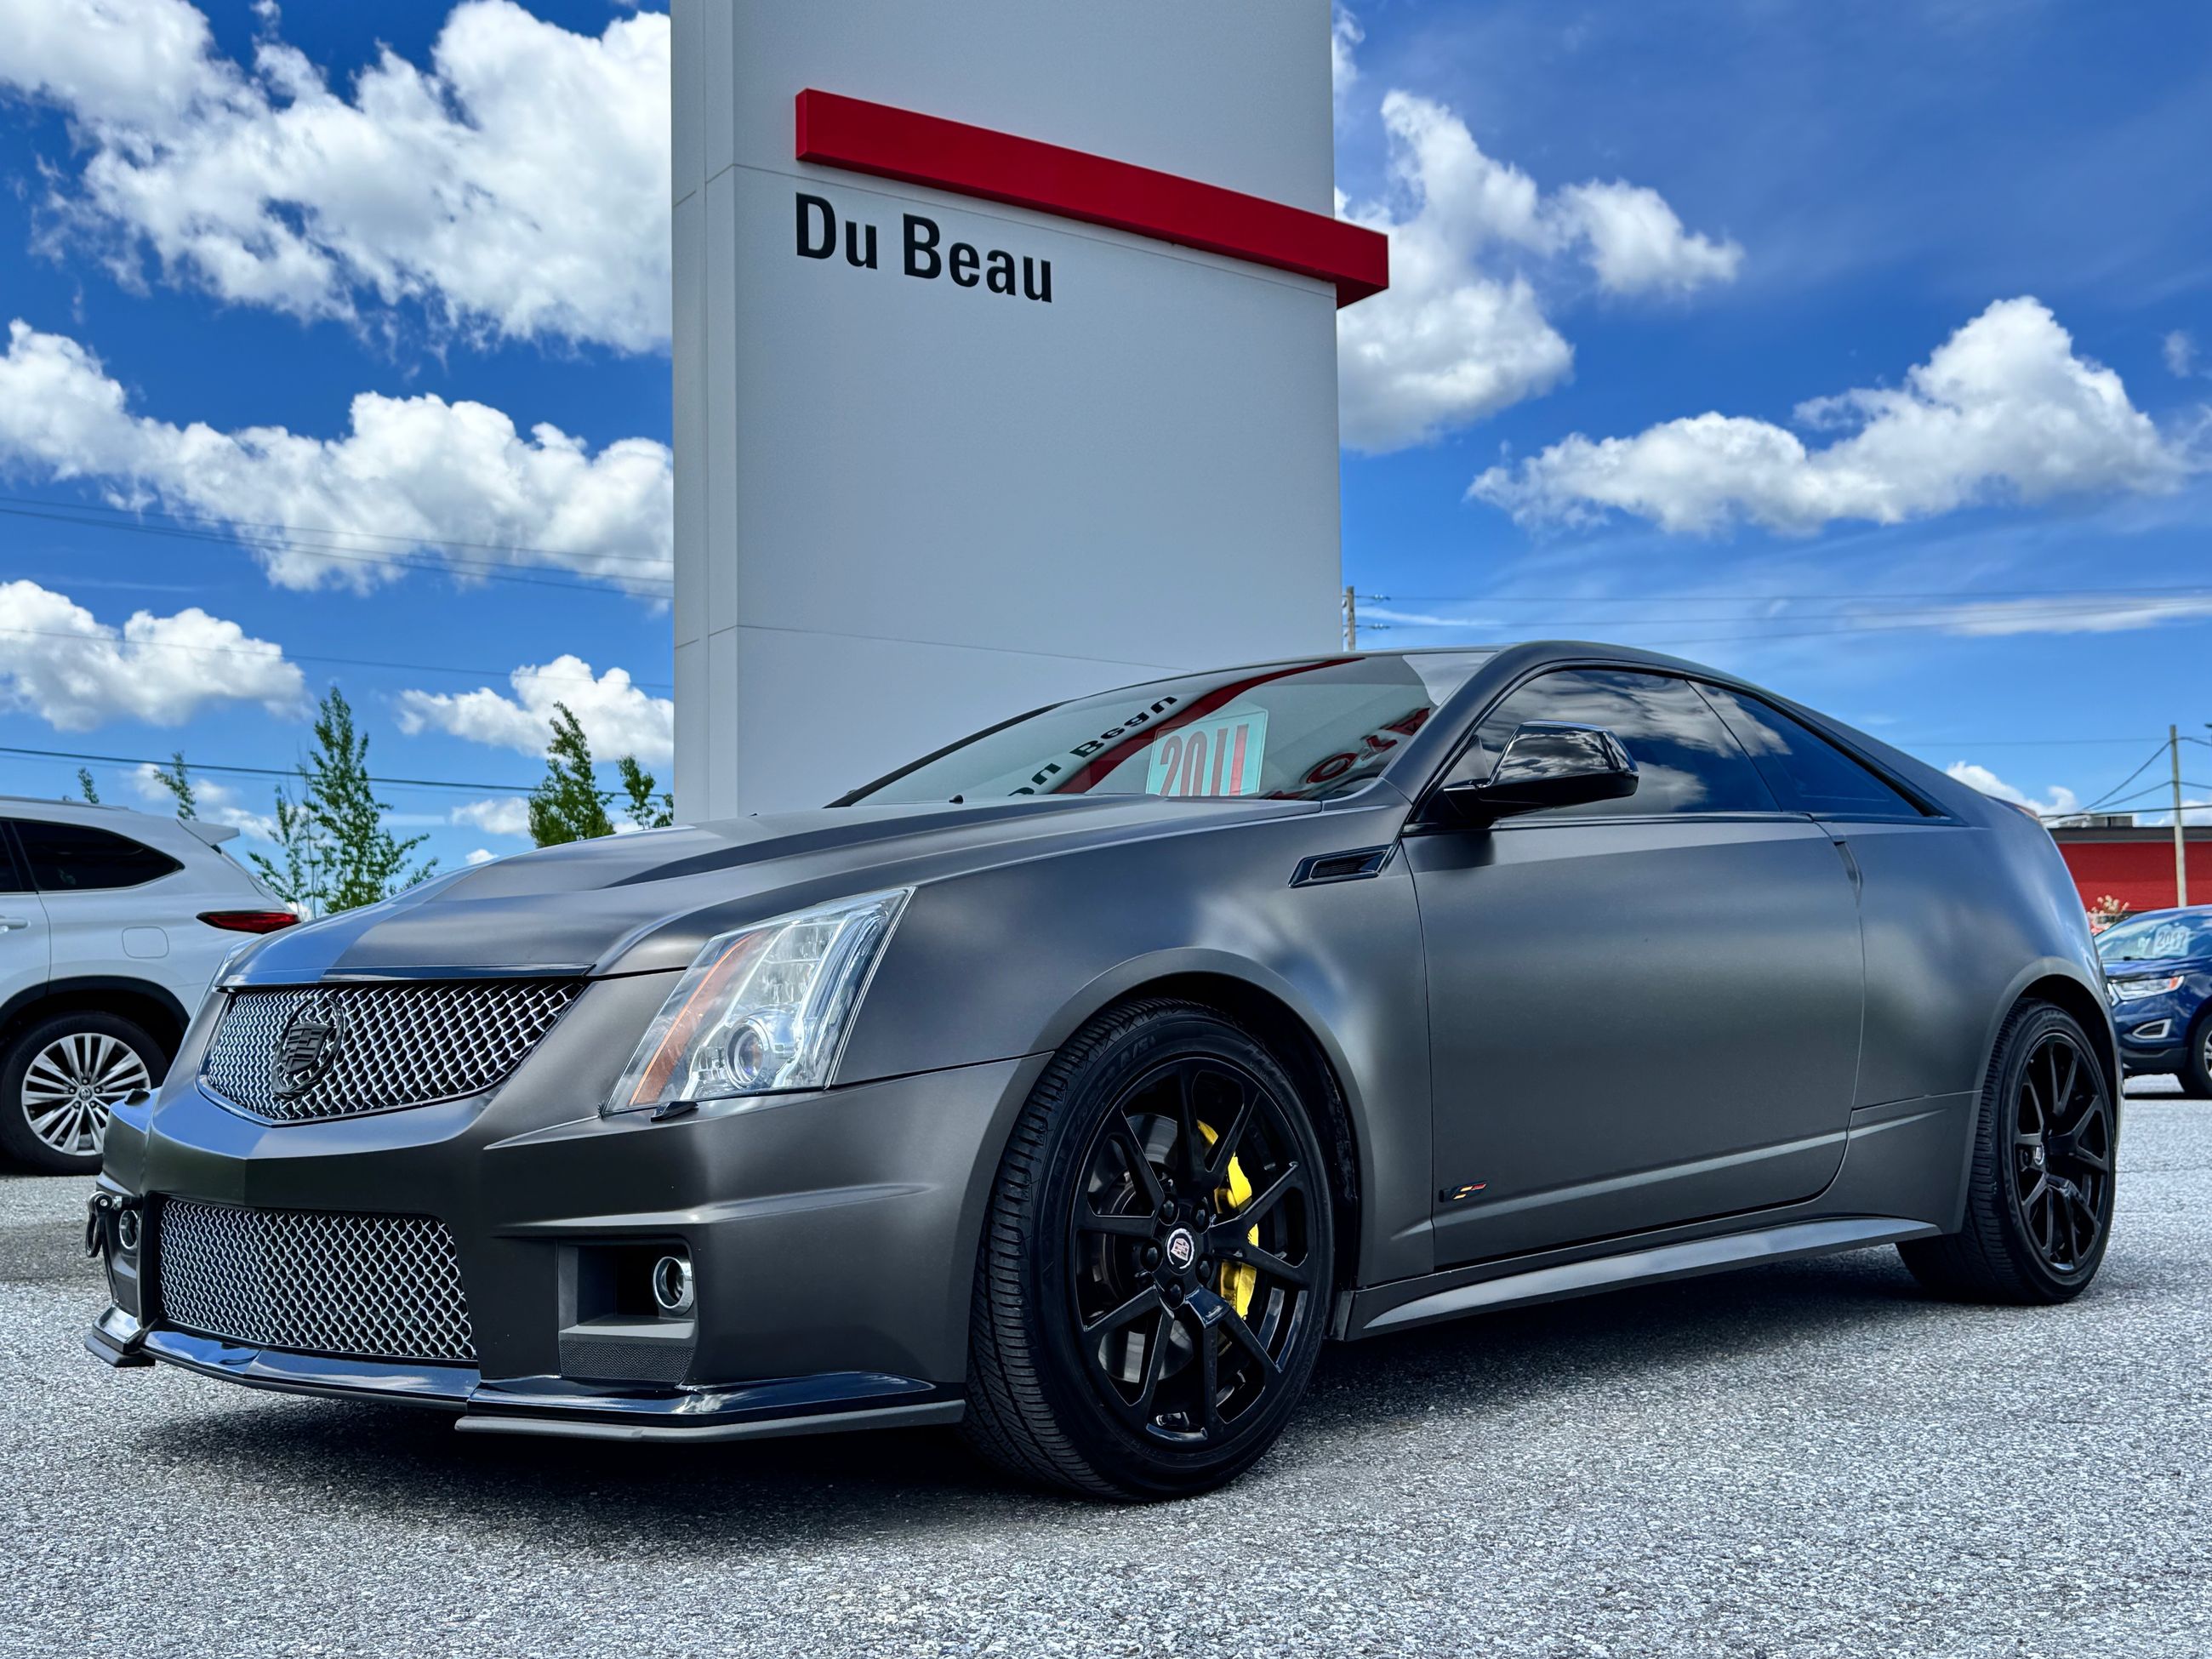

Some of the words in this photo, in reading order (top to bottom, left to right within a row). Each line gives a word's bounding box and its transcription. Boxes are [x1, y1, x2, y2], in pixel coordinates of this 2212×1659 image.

[795, 191, 877, 270] Du
[903, 213, 1052, 303] Beau
[1160, 723, 1249, 796] 2011
